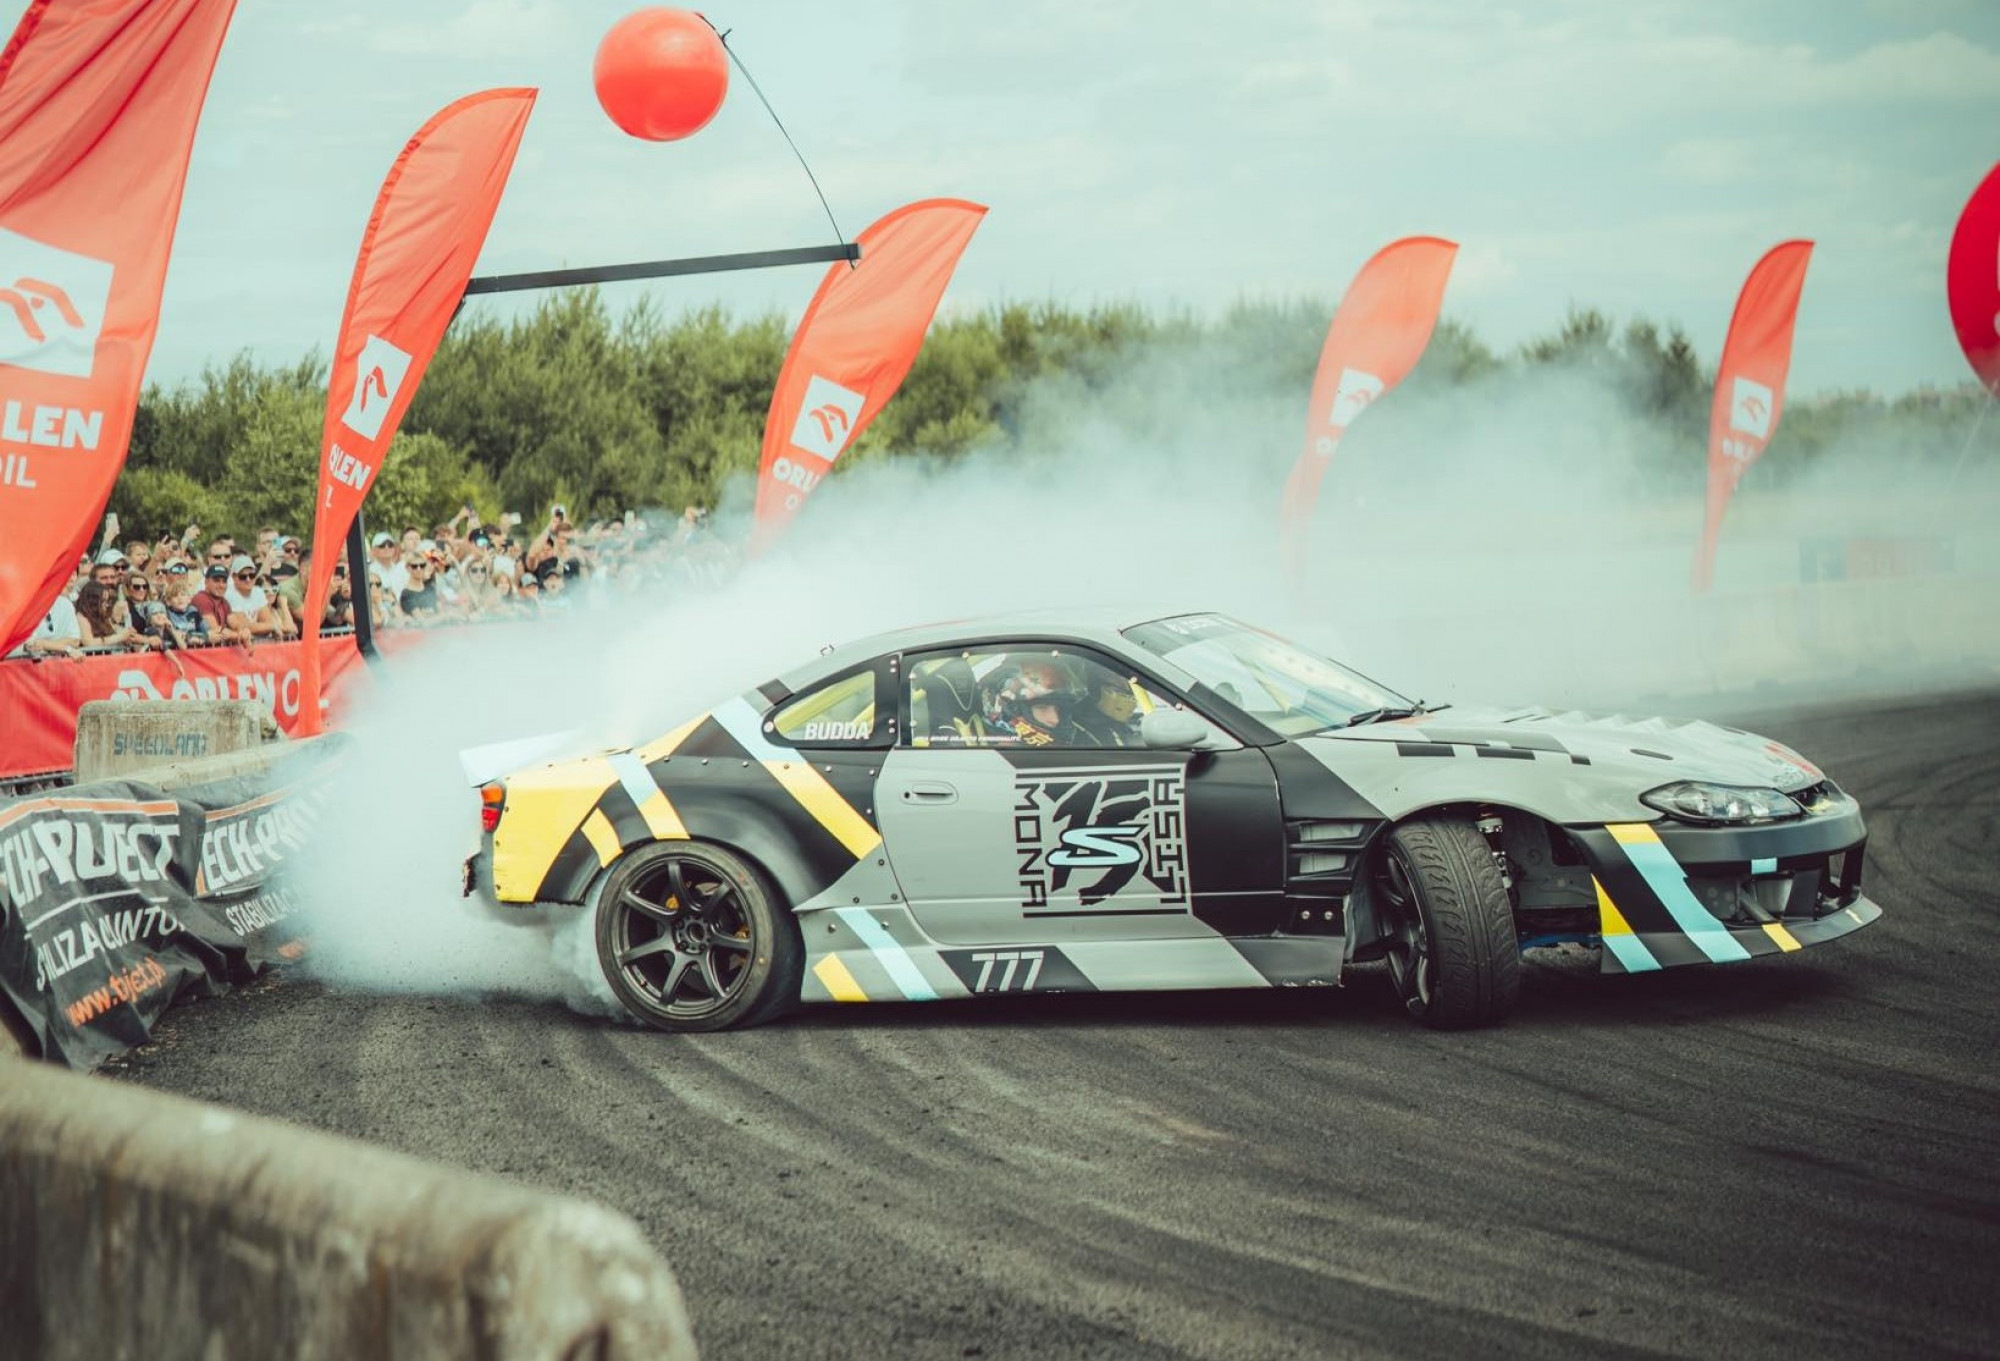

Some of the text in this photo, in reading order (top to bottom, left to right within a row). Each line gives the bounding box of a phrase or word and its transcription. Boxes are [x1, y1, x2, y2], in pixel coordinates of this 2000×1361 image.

[804, 721, 869, 740] BUDDA
[1014, 783, 1048, 908] MONA
[971, 950, 1044, 993] 777
